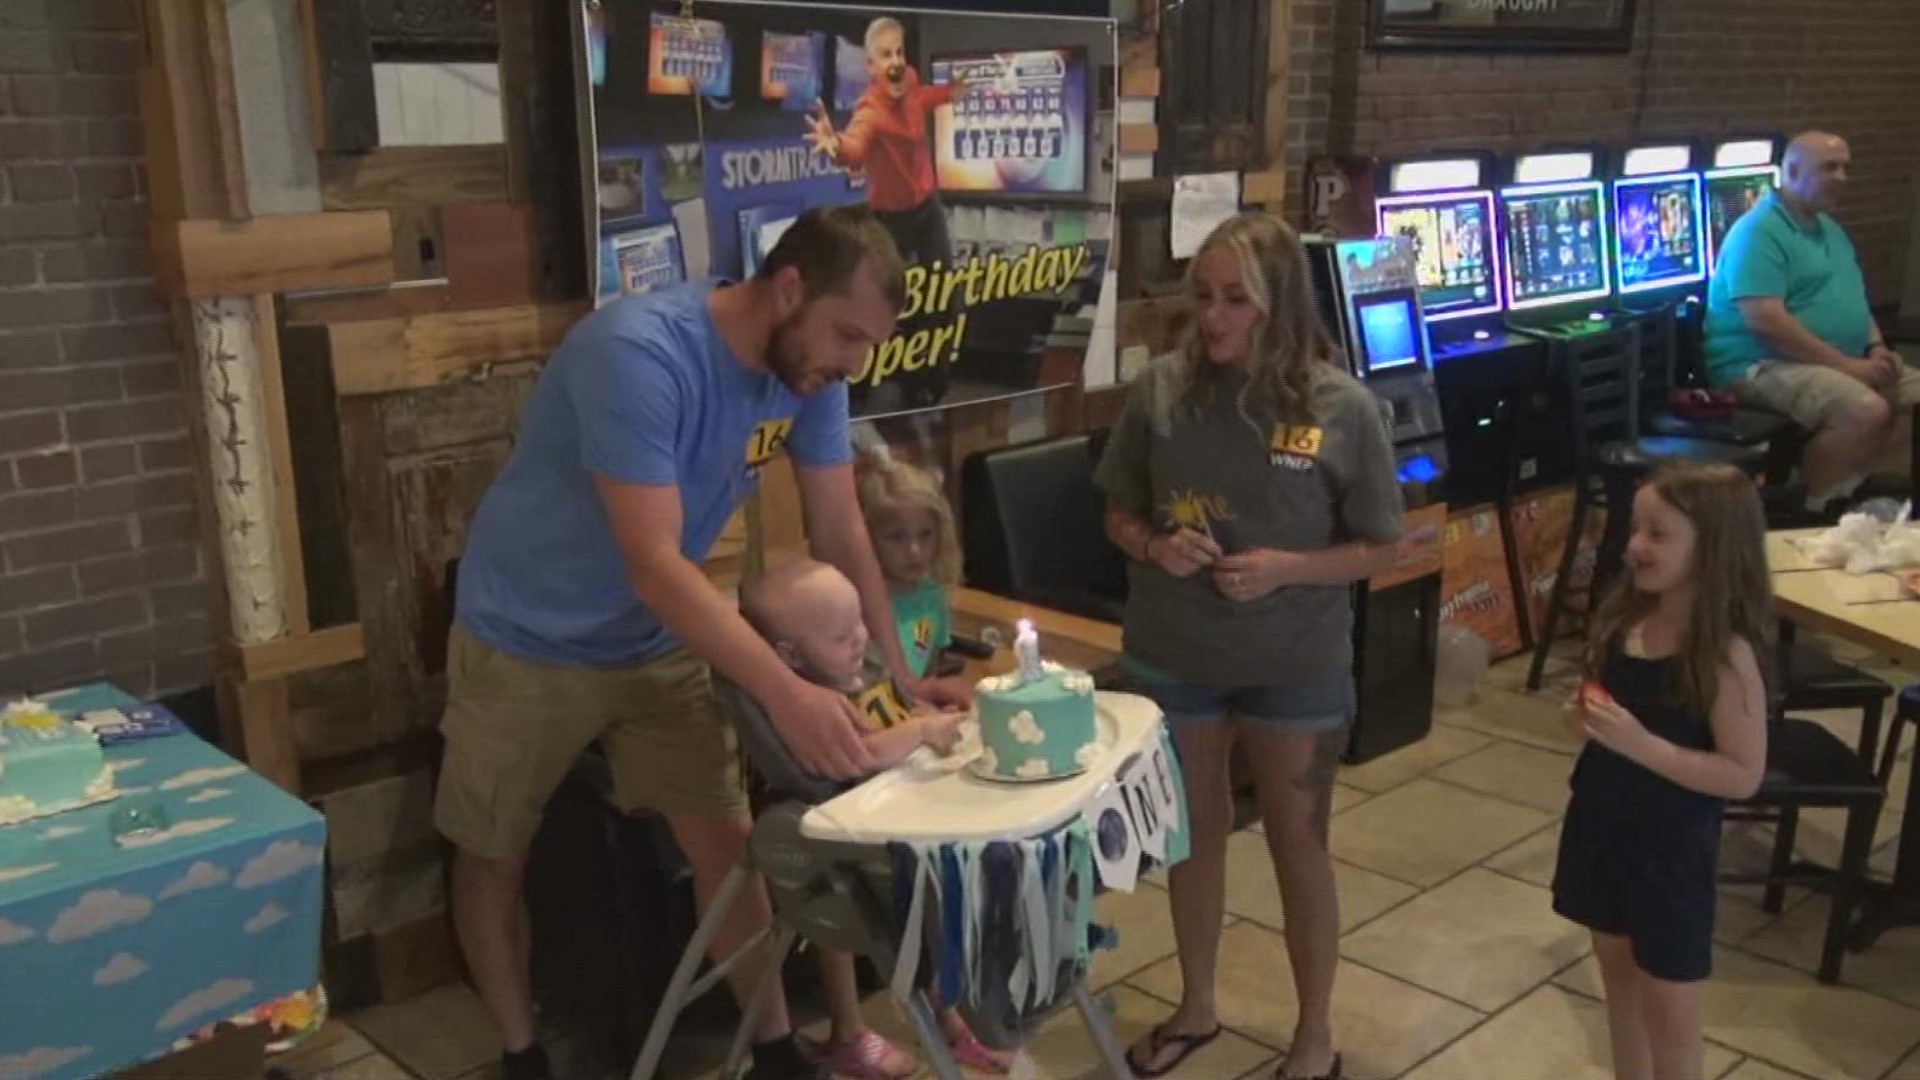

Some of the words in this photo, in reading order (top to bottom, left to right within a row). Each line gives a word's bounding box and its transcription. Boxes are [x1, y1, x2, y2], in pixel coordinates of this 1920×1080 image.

[897, 244, 1086, 321] Birthday
[1281, 424, 1314, 450] 16
[1270, 452, 1314, 472] WNEP
